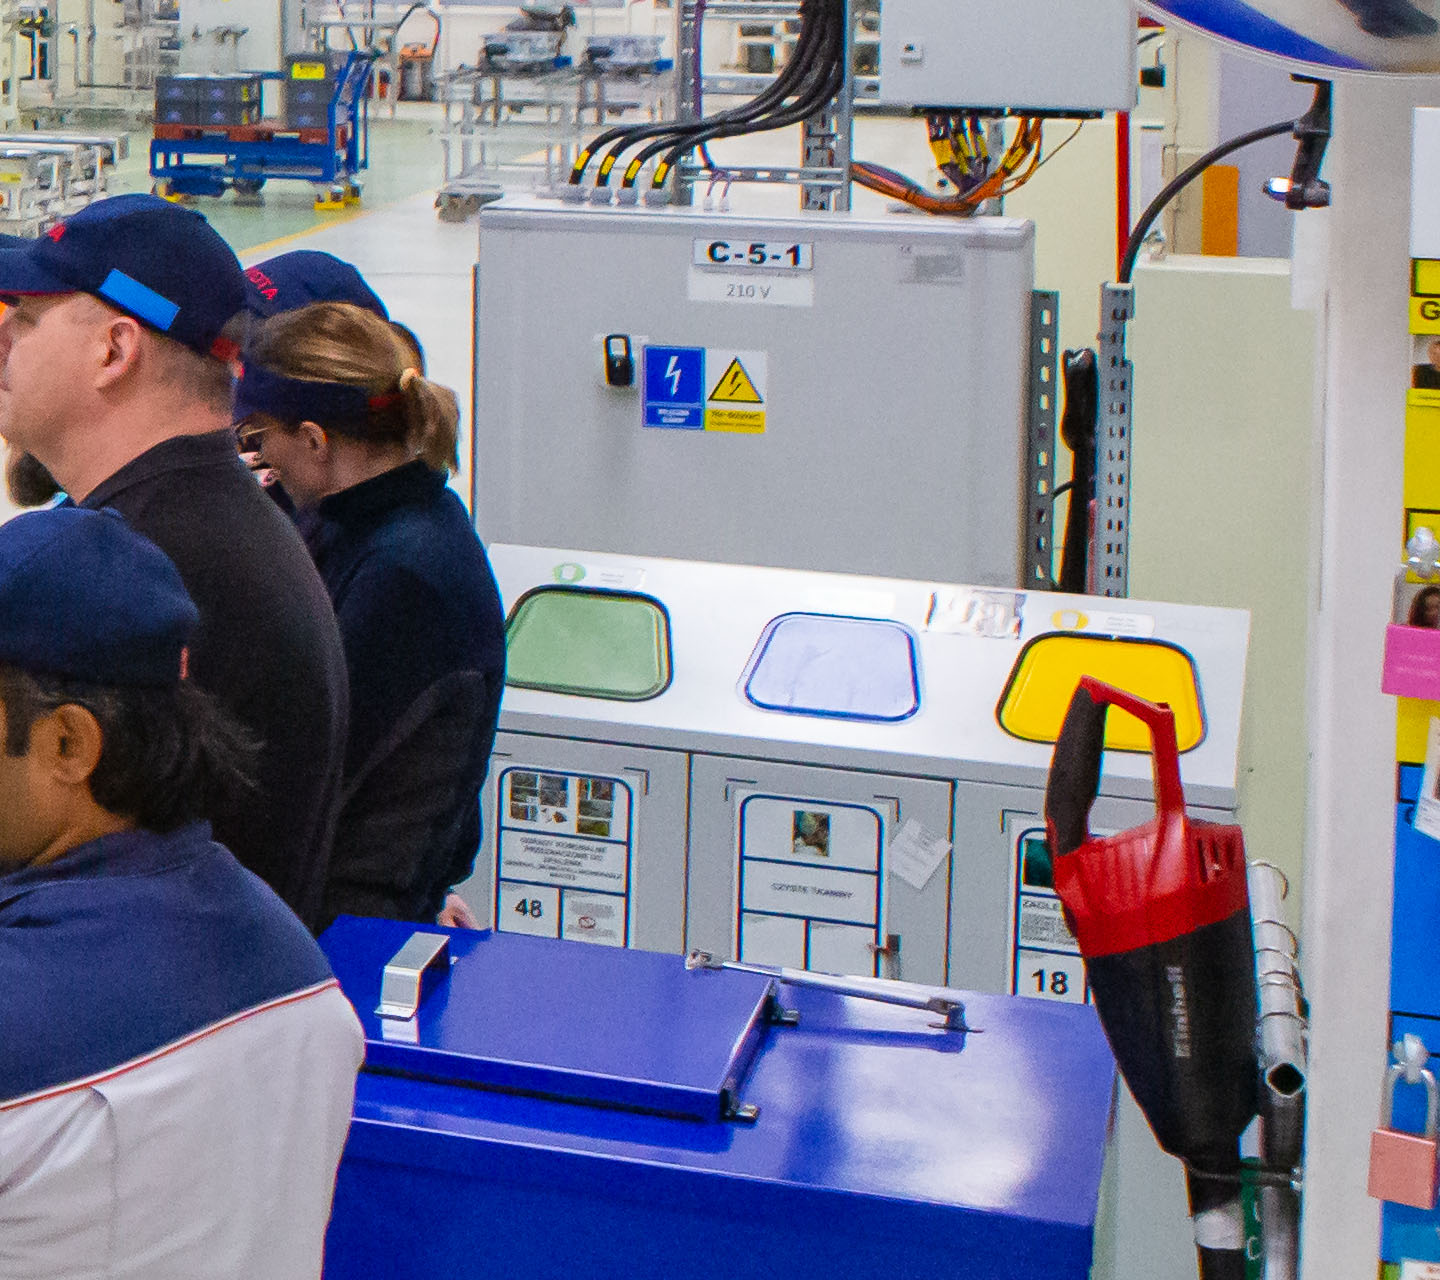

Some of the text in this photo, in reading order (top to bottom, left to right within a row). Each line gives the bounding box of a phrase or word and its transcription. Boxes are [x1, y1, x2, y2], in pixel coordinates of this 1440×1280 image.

[708, 240, 802, 268] C-5-1
[726, 283, 772, 299] 210 V
[514, 898, 543, 919] 48
[1031, 967, 1069, 995] 18
